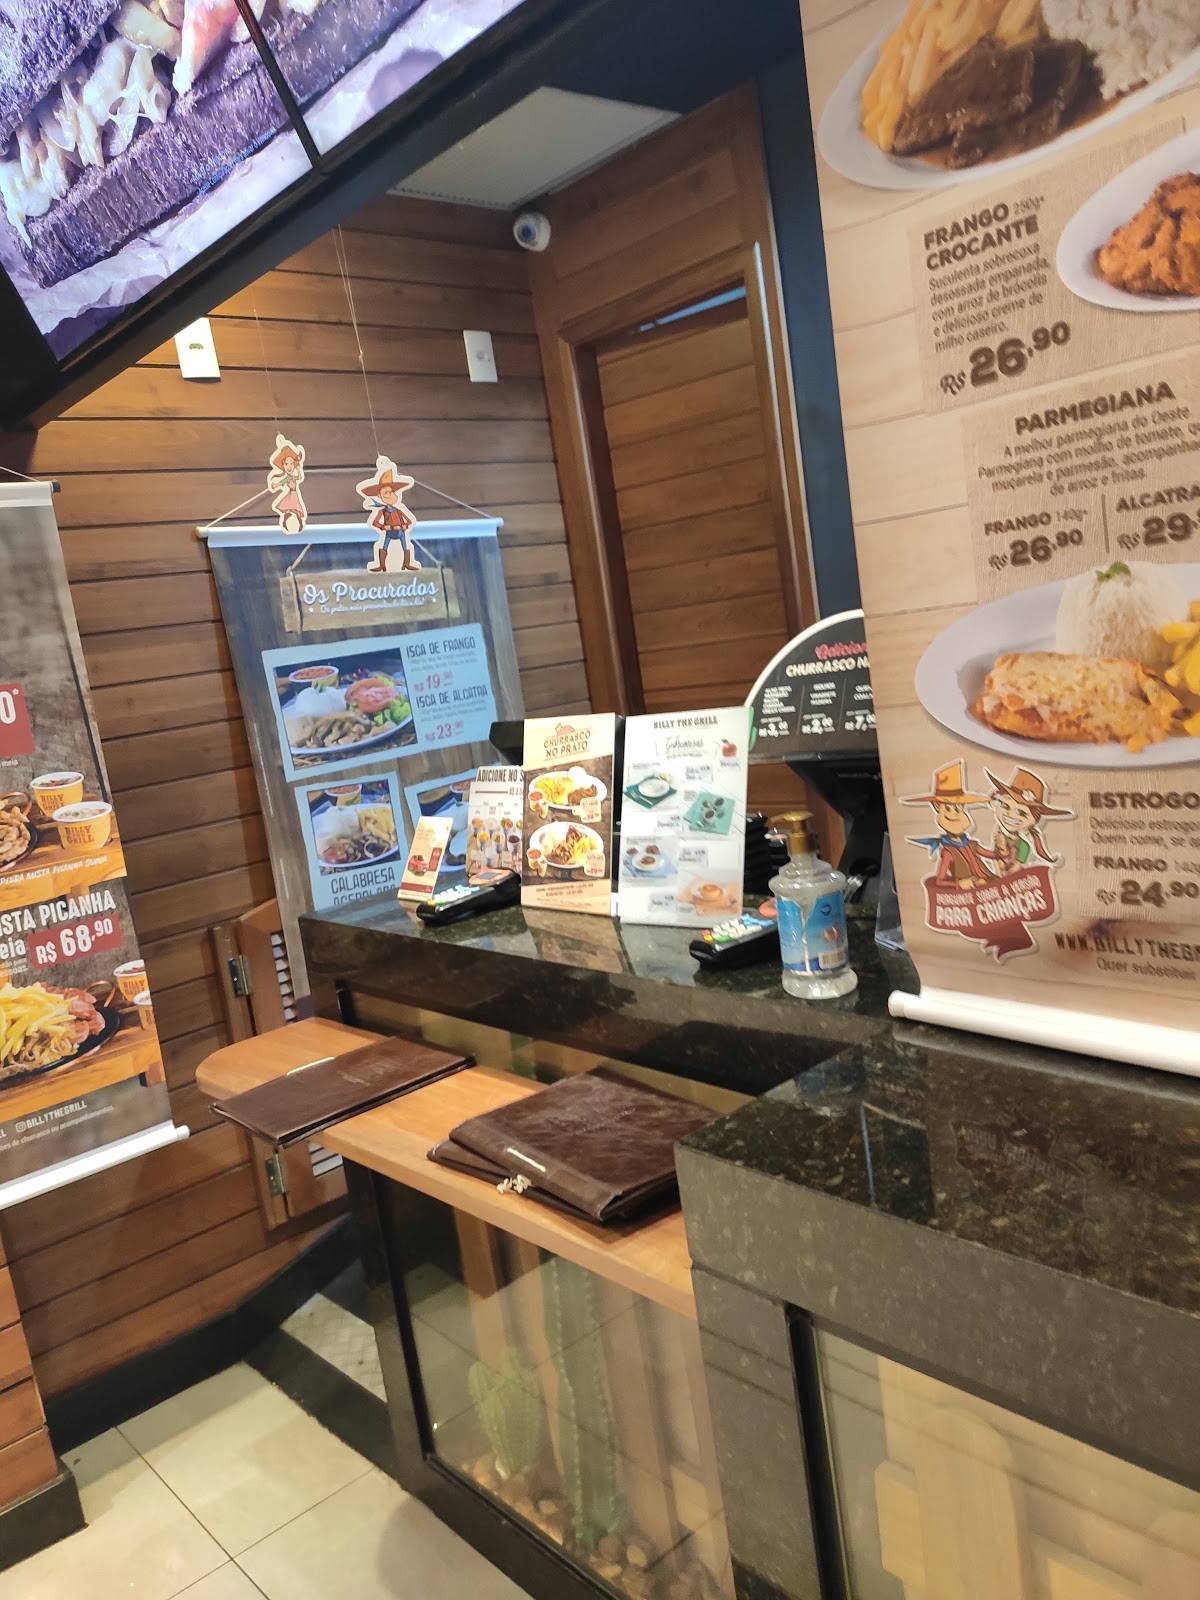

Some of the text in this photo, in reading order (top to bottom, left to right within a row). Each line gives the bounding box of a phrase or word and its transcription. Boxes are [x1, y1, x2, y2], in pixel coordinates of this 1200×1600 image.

[924, 202, 1009, 250] FRANGO
[926, 214, 1039, 271] CROCANTE
[932, 306, 955, 321] com
[957, 296, 984, 314] arroz
[986, 289, 1000, 303] de
[933, 327, 941, 337] e
[935, 335, 965, 353] milho
[1015, 381, 1176, 436] PARMEGIANA
[1116, 483, 1200, 513] ALCATRA
[984, 511, 1052, 536] FRANGO
[1142, 511, 1200, 546] 29,
[303, 584, 329, 605] Os
[332, 577, 438, 603] Procurados
[406, 644, 426, 658] ISCA
[429, 641, 440, 655] DE
[443, 636, 476, 653] FRANGO
[785, 655, 870, 678] CHURRASCO N
[416, 693, 436, 709] ISCA
[439, 691, 450, 705] DE
[453, 685, 488, 702] ALCATRA
[653, 720, 675, 729] BILLY
[693, 715, 719, 726] GRILL
[543, 729, 591, 749] CHURRASCO
[545, 741, 588, 758] NO PRATO
[477, 768, 507, 783] ADICIONE
[508, 768, 518, 782] NO
[1093, 856, 1168, 873] FRANGO
[330, 866, 396, 894] CALABRESA
[38, 889, 117, 926] PICANHA
[936, 888, 1047, 927] PARA CRIANÇAS
[35, 918, 113, 964] R$ 68,90
